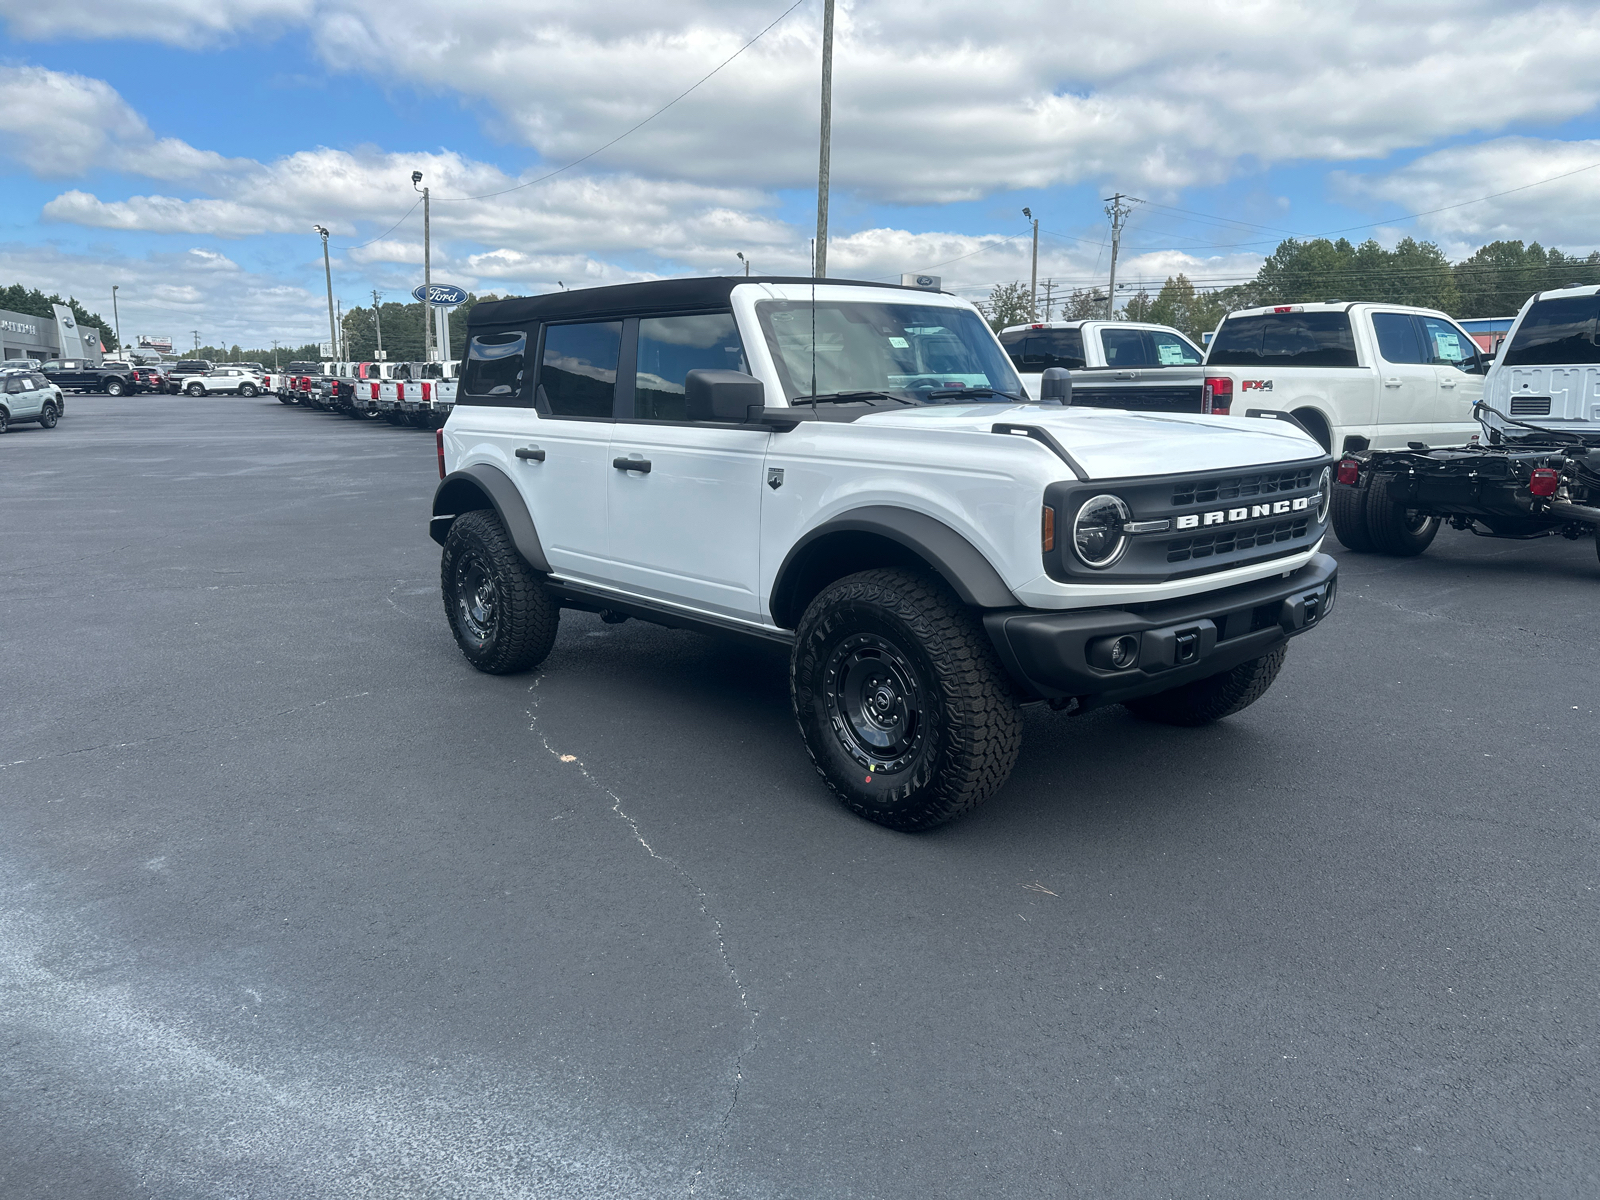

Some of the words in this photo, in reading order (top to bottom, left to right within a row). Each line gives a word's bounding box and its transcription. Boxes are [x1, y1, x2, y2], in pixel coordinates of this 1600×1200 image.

[429, 286, 458, 302] Ford
[1242, 379, 1273, 392] FX4
[1176, 497, 1308, 529] BRONCO
